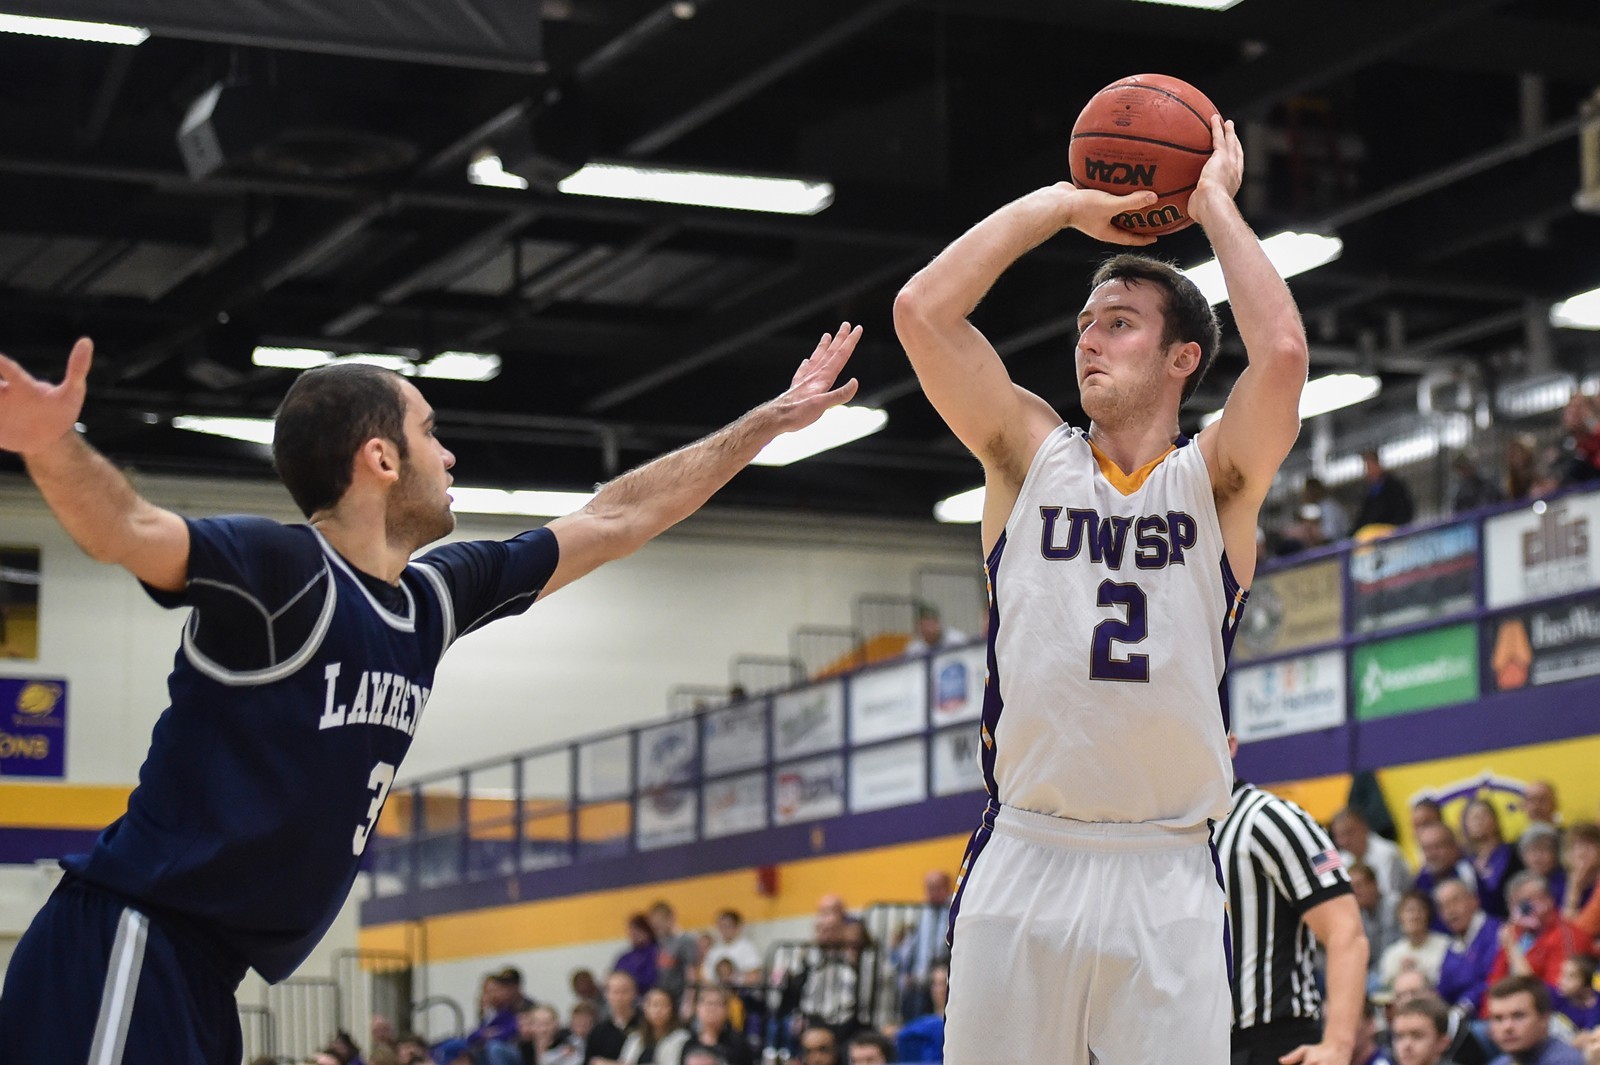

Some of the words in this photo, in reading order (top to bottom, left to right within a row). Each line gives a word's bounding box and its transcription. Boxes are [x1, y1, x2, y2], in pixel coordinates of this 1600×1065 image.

[1086, 158, 1156, 186] NCAA
[1039, 506, 1198, 571] UWSP
[1089, 578, 1150, 683] 2
[352, 761, 395, 857] 3
